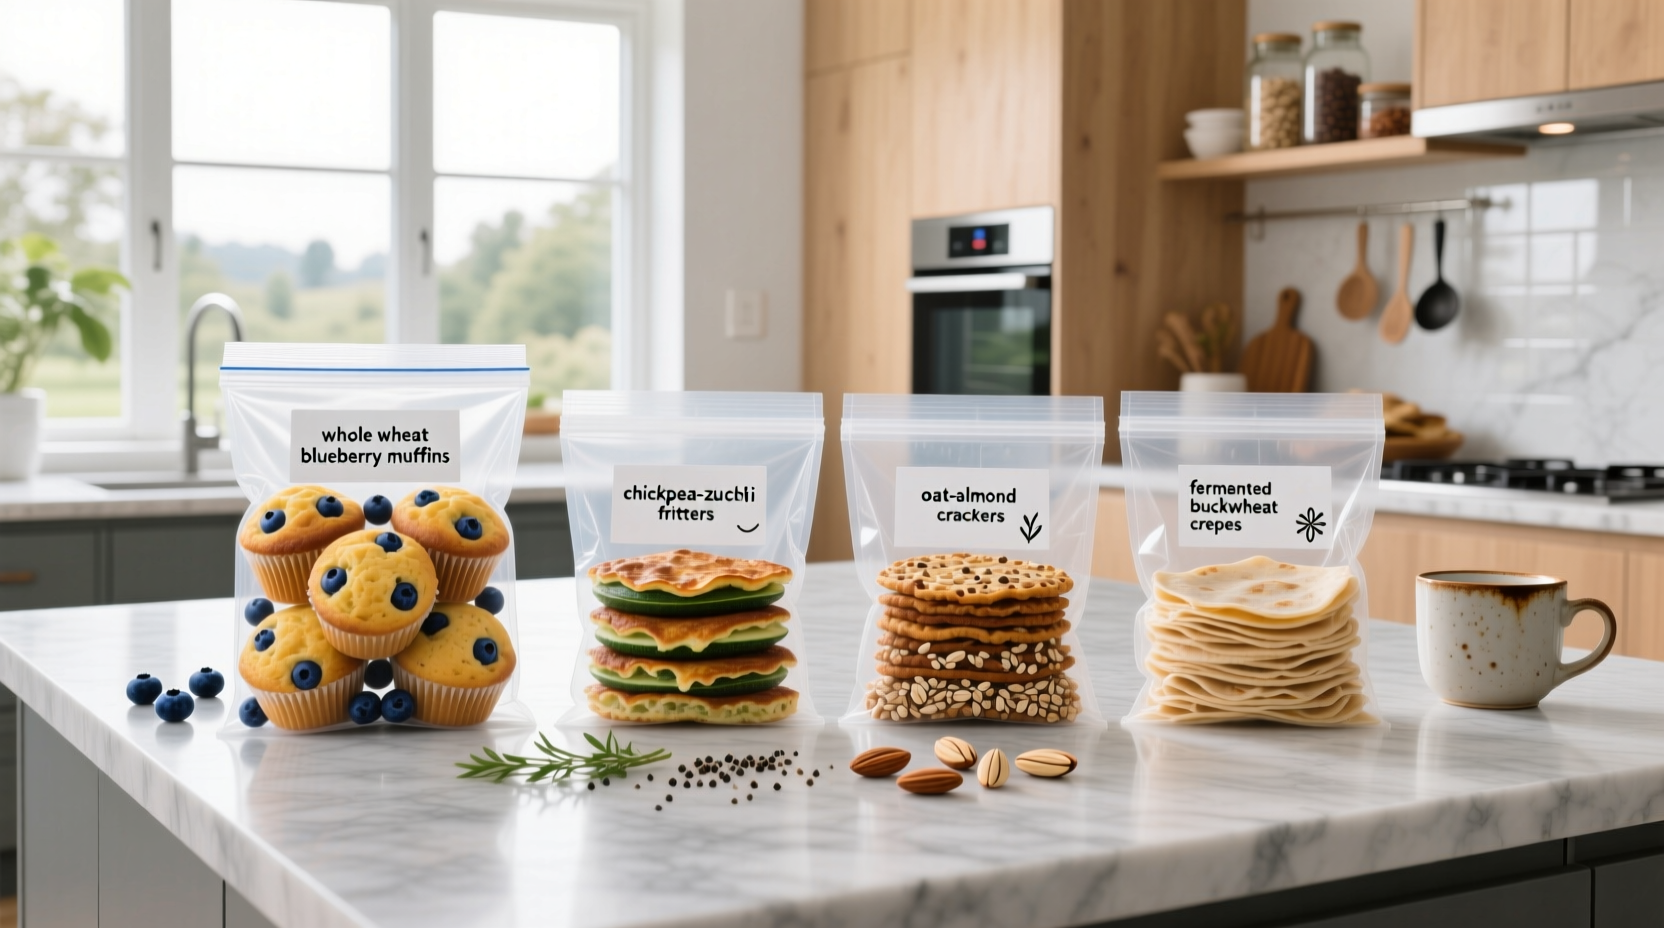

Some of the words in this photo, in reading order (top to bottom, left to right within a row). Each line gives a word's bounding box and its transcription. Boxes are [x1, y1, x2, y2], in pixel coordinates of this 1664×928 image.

[321, 425, 373, 443] whole
[377, 425, 429, 443] wheat
[300, 446, 383, 468] blueberry
[387, 446, 450, 464] muffins
[921, 486, 1017, 504] oat-almond
[657, 505, 715, 522] fritters
[1190, 496, 1279, 514] buckwheat
[936, 508, 1005, 523] crackers
[1190, 519, 1243, 536] crepes
